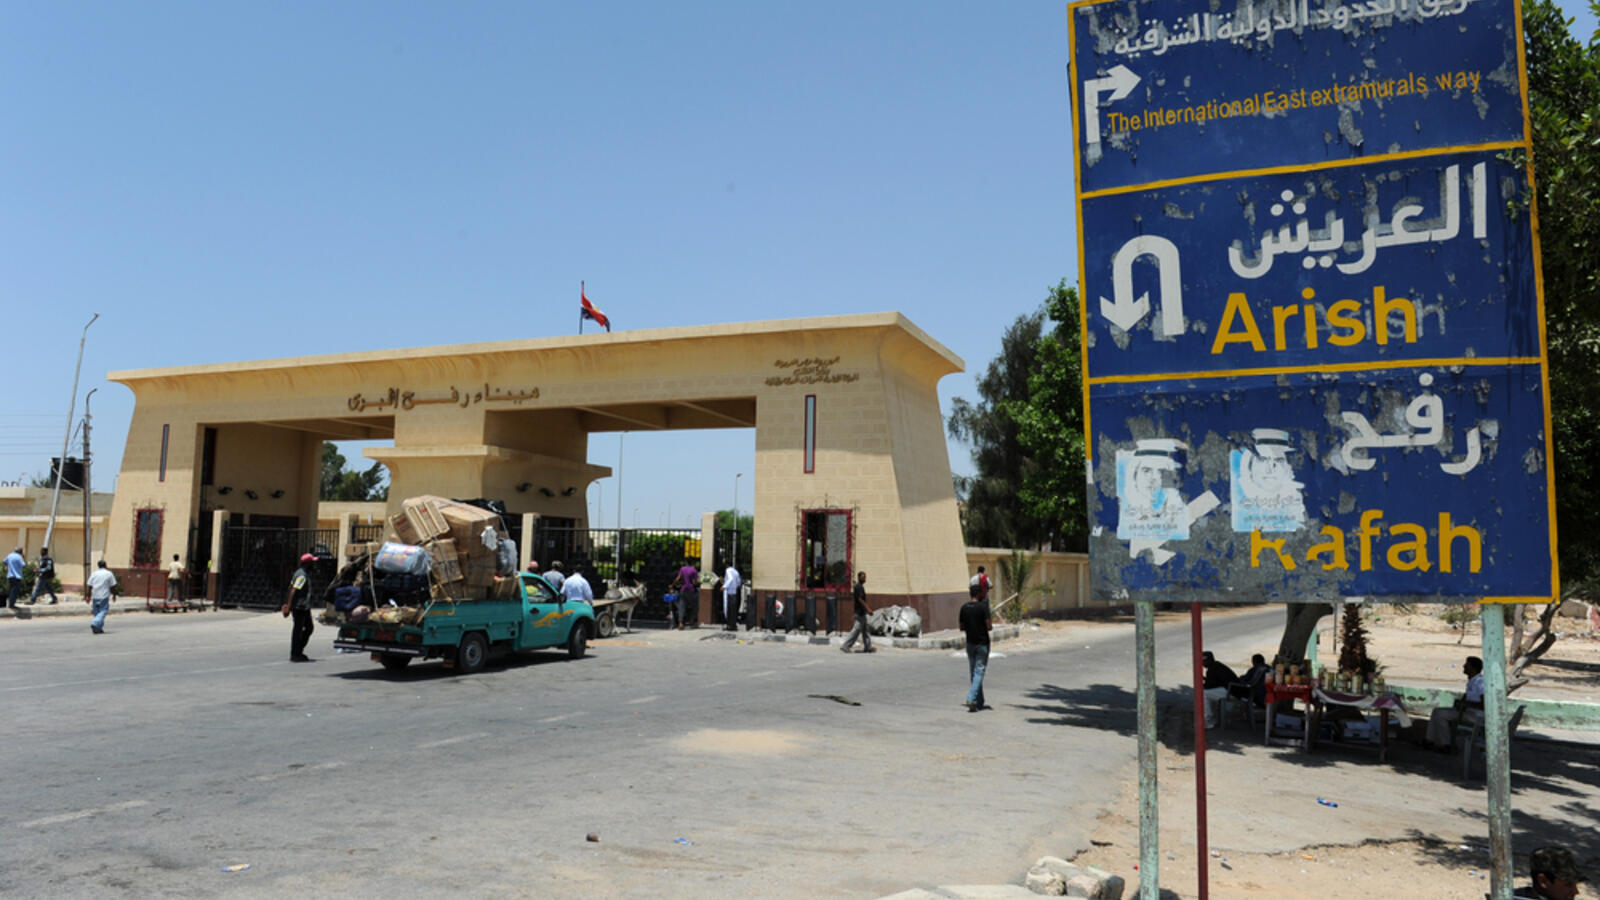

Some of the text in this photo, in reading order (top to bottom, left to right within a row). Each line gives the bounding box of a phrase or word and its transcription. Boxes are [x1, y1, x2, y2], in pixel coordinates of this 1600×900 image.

[1113, 12, 1211, 59] الشرقية
[1216, 0, 1310, 45] الدولية
[1107, 70, 1482, 133] The International East extramurals way
[1228, 162, 1488, 279] العريش
[1211, 285, 1418, 355] Arish
[402, 386, 470, 410] رفح
[474, 383, 540, 405] ميناء
[1341, 372, 1482, 476] رفح
